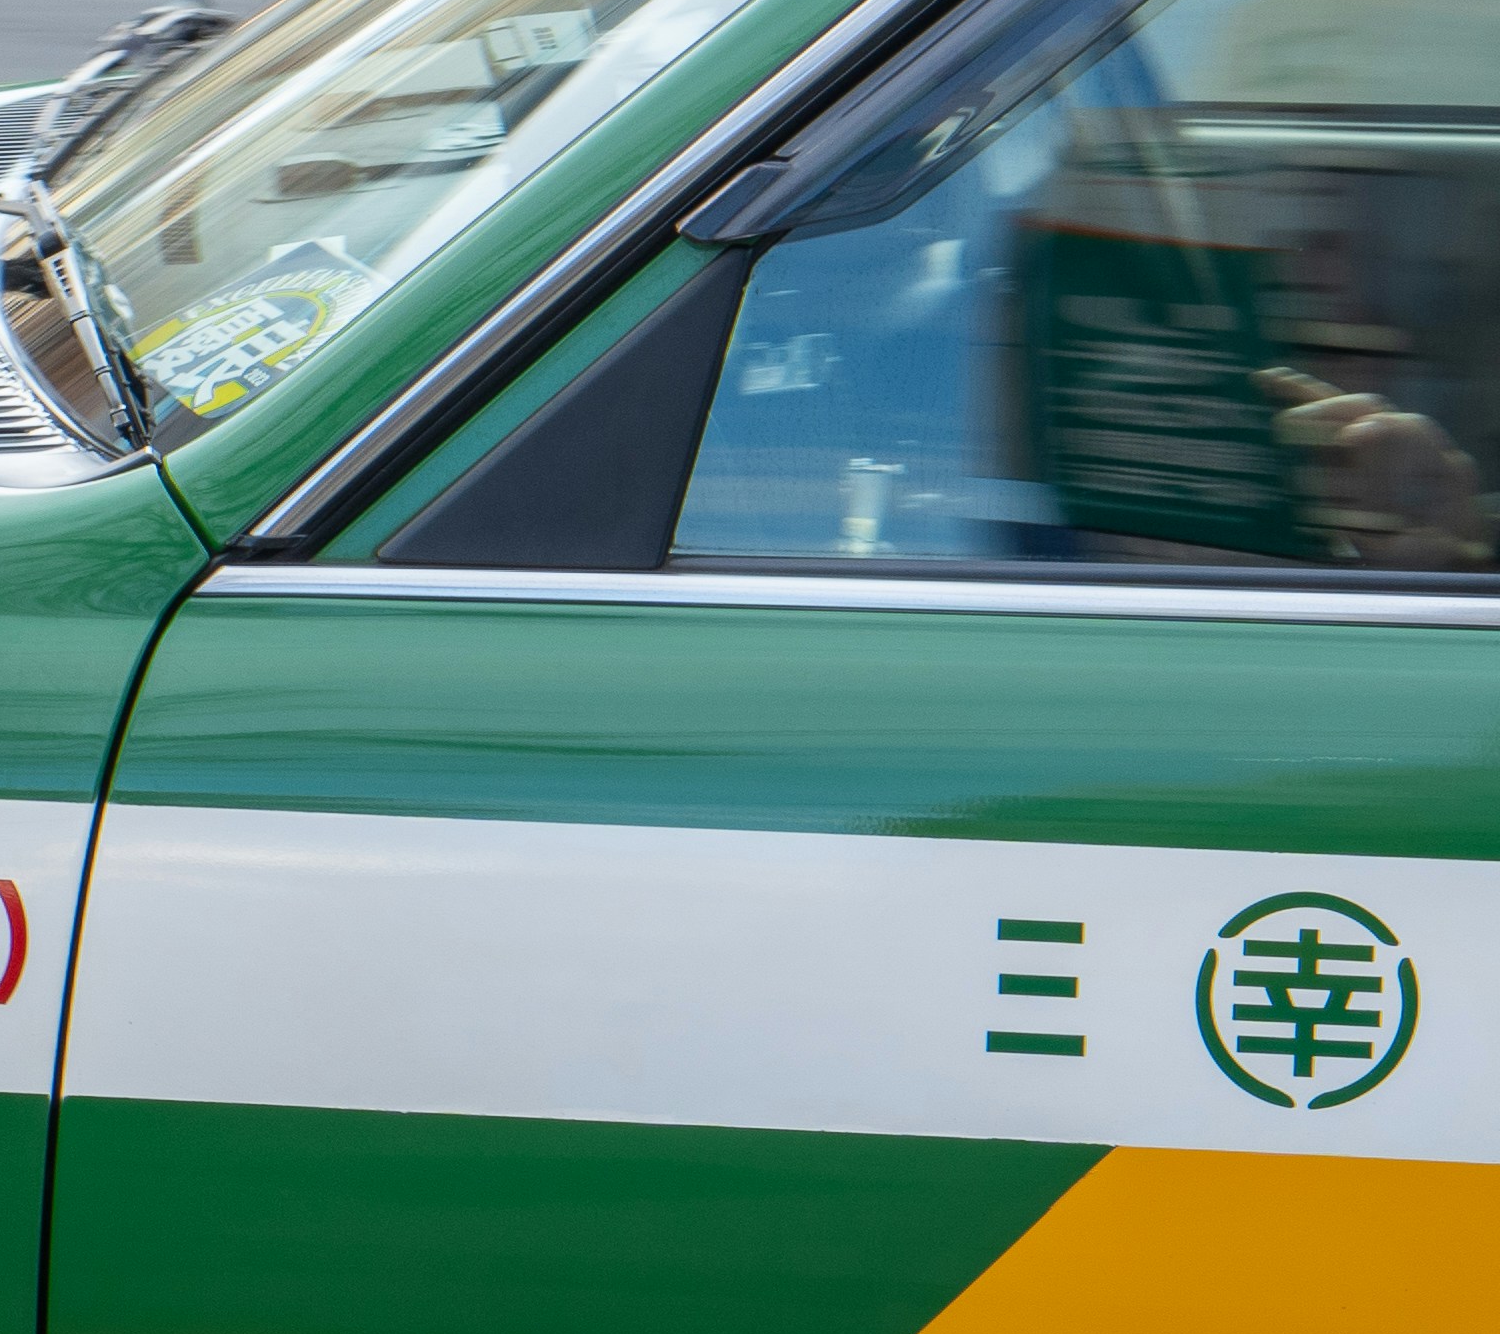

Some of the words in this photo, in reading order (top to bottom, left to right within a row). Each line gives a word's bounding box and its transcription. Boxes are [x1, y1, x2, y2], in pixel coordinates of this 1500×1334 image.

[133, 296, 311, 408] 優良
[985, 917, 1087, 1057] 三
[1226, 923, 1390, 1083] 幸
